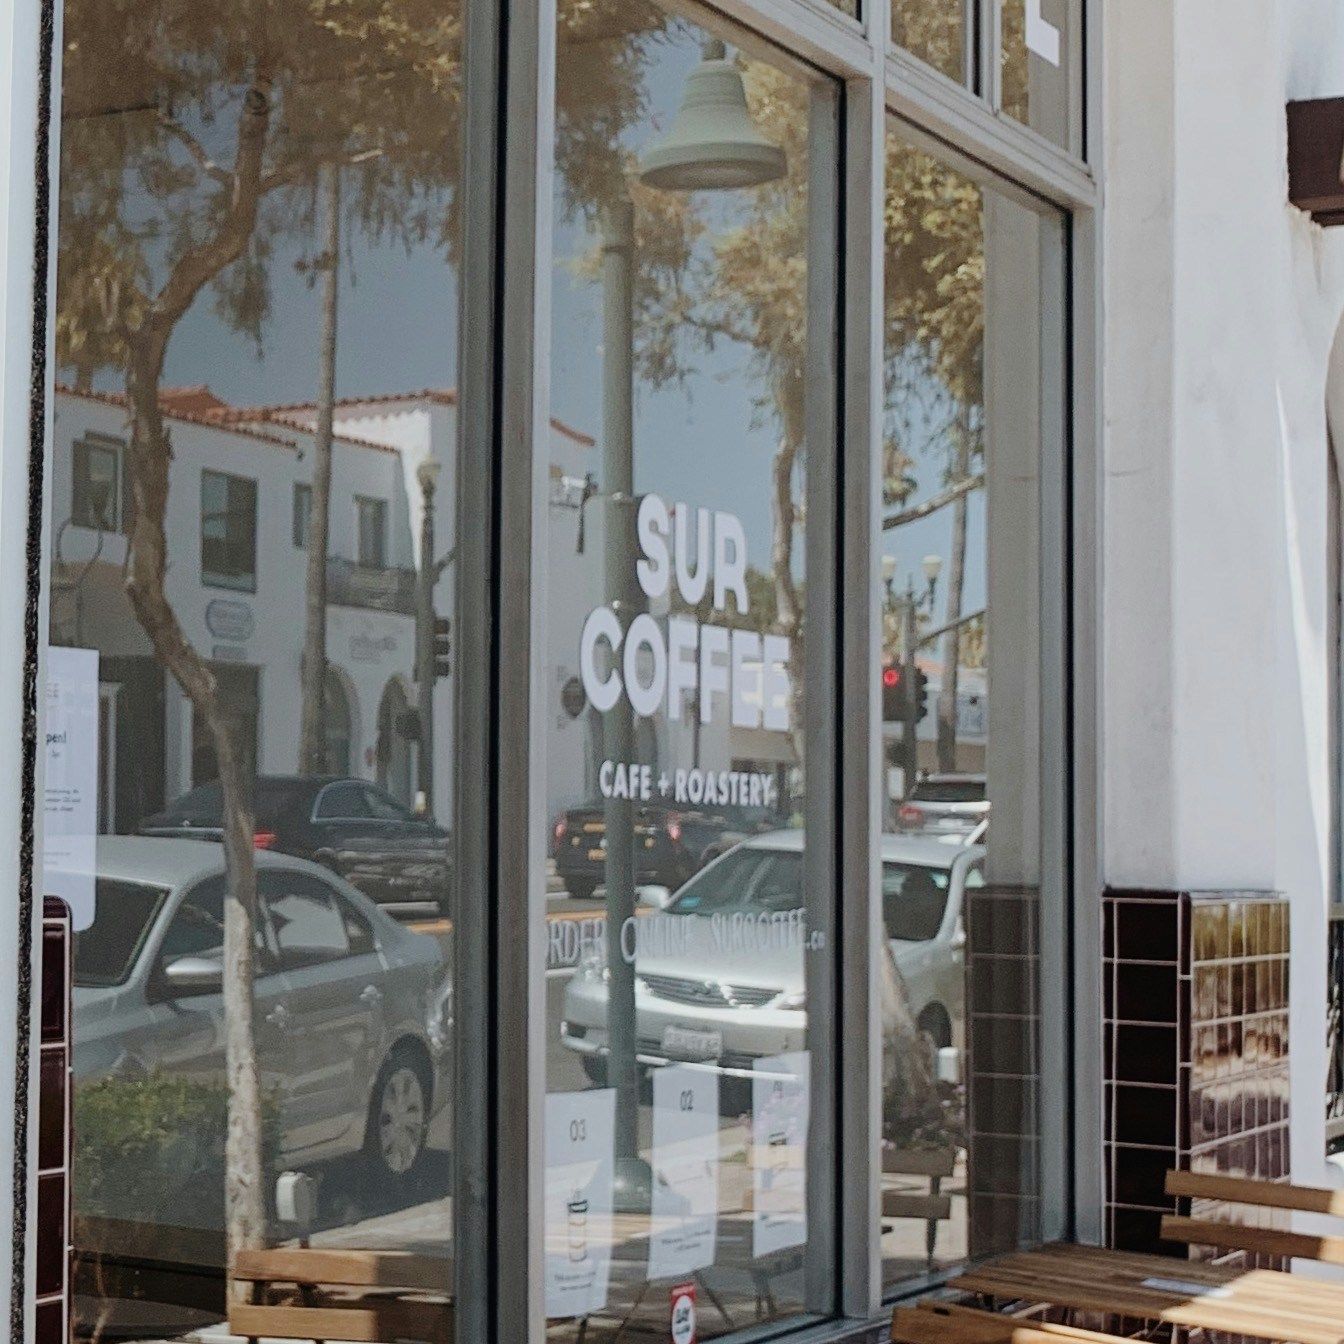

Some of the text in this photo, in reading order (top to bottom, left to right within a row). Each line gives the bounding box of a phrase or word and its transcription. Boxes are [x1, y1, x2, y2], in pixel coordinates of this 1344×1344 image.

[636, 493, 749, 616] SUR
[580, 606, 791, 732] COFFEE
[599, 759, 774, 807] CAFE + ROASTERY
[546, 917, 608, 966] RDER
